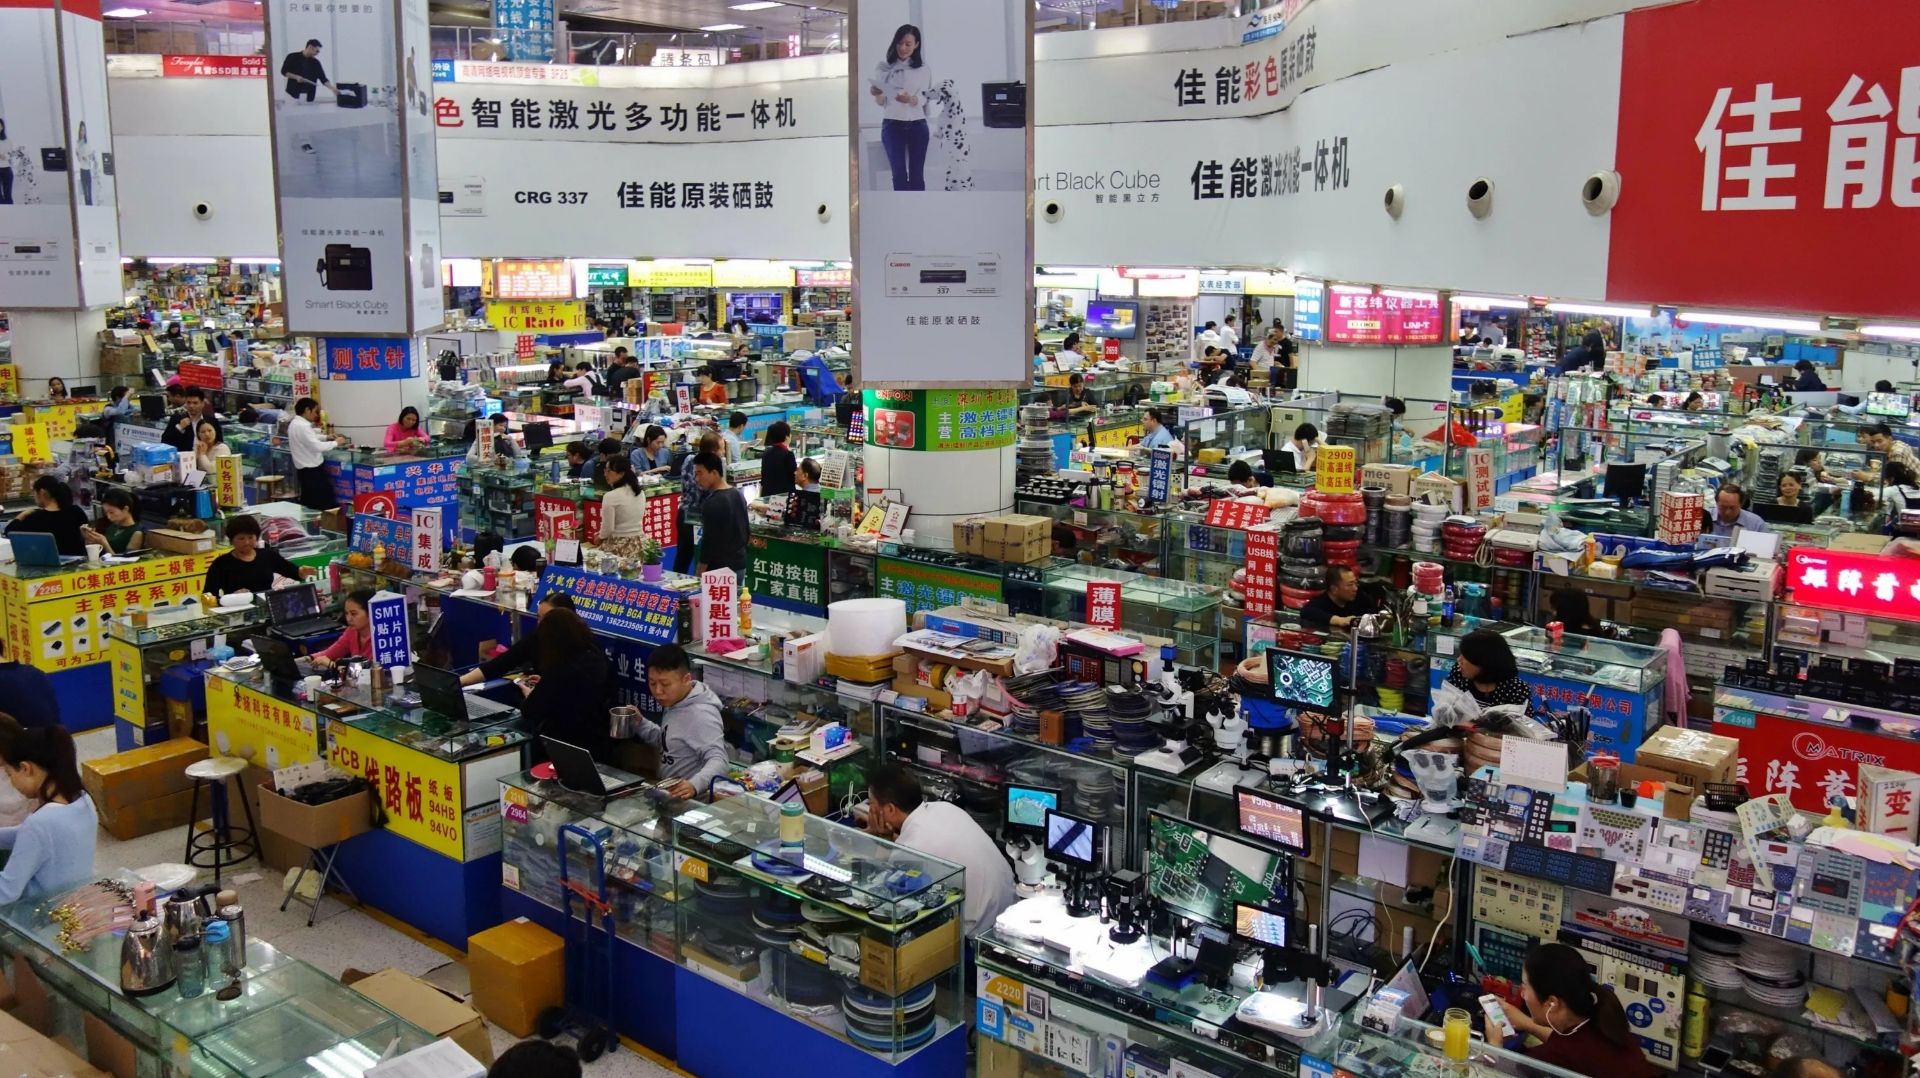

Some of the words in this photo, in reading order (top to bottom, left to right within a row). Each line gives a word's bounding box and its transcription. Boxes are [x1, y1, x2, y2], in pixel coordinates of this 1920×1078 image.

[1056, 172, 1105, 190] Black
[1110, 170, 1160, 190] Cube
[514, 191, 553, 204] CRG
[557, 191, 588, 205] 337
[617, 181, 774, 209] 佳能原装硒鼓
[937, 287, 950, 295] 337
[305, 300, 334, 309] Smart
[336, 300, 361, 309] Black
[363, 300, 389, 309] Cube
[503, 316, 518, 329] IC
[906, 315, 981, 326] 佳能原装硒鼓
[333, 347, 405, 371] 测试针
[294, 371, 310, 396] 电池
[678, 389, 691, 414] 电池
[1327, 451, 1353, 460] 2909
[1326, 461, 1353, 474] 高温线
[1364, 470, 1391, 480] mec
[1326, 476, 1352, 489] 高压线
[1247, 533, 1275, 546] VGA线
[1247, 547, 1274, 559] USB线
[71, 567, 146, 591] IC集成电路
[154, 558, 196, 577] 二极管
[753, 557, 819, 585] 红波按钮
[704, 575, 736, 585] ID/IC
[1247, 574, 1274, 587] 音箱线
[753, 577, 818, 604] 厂家直销
[374, 605, 401, 620] SMT
[627, 608, 642, 620] BGA
[709, 585, 731, 639] 钥匙扣
[377, 620, 403, 636] 贴片
[378, 636, 402, 650] DIP
[380, 650, 406, 665] 插件
[333, 746, 360, 771] PCB
[1805, 741, 1886, 767] MATRIX
[429, 799, 455, 821] 94HB
[688, 863, 705, 877] 2219
[996, 981, 1021, 999] 2220
